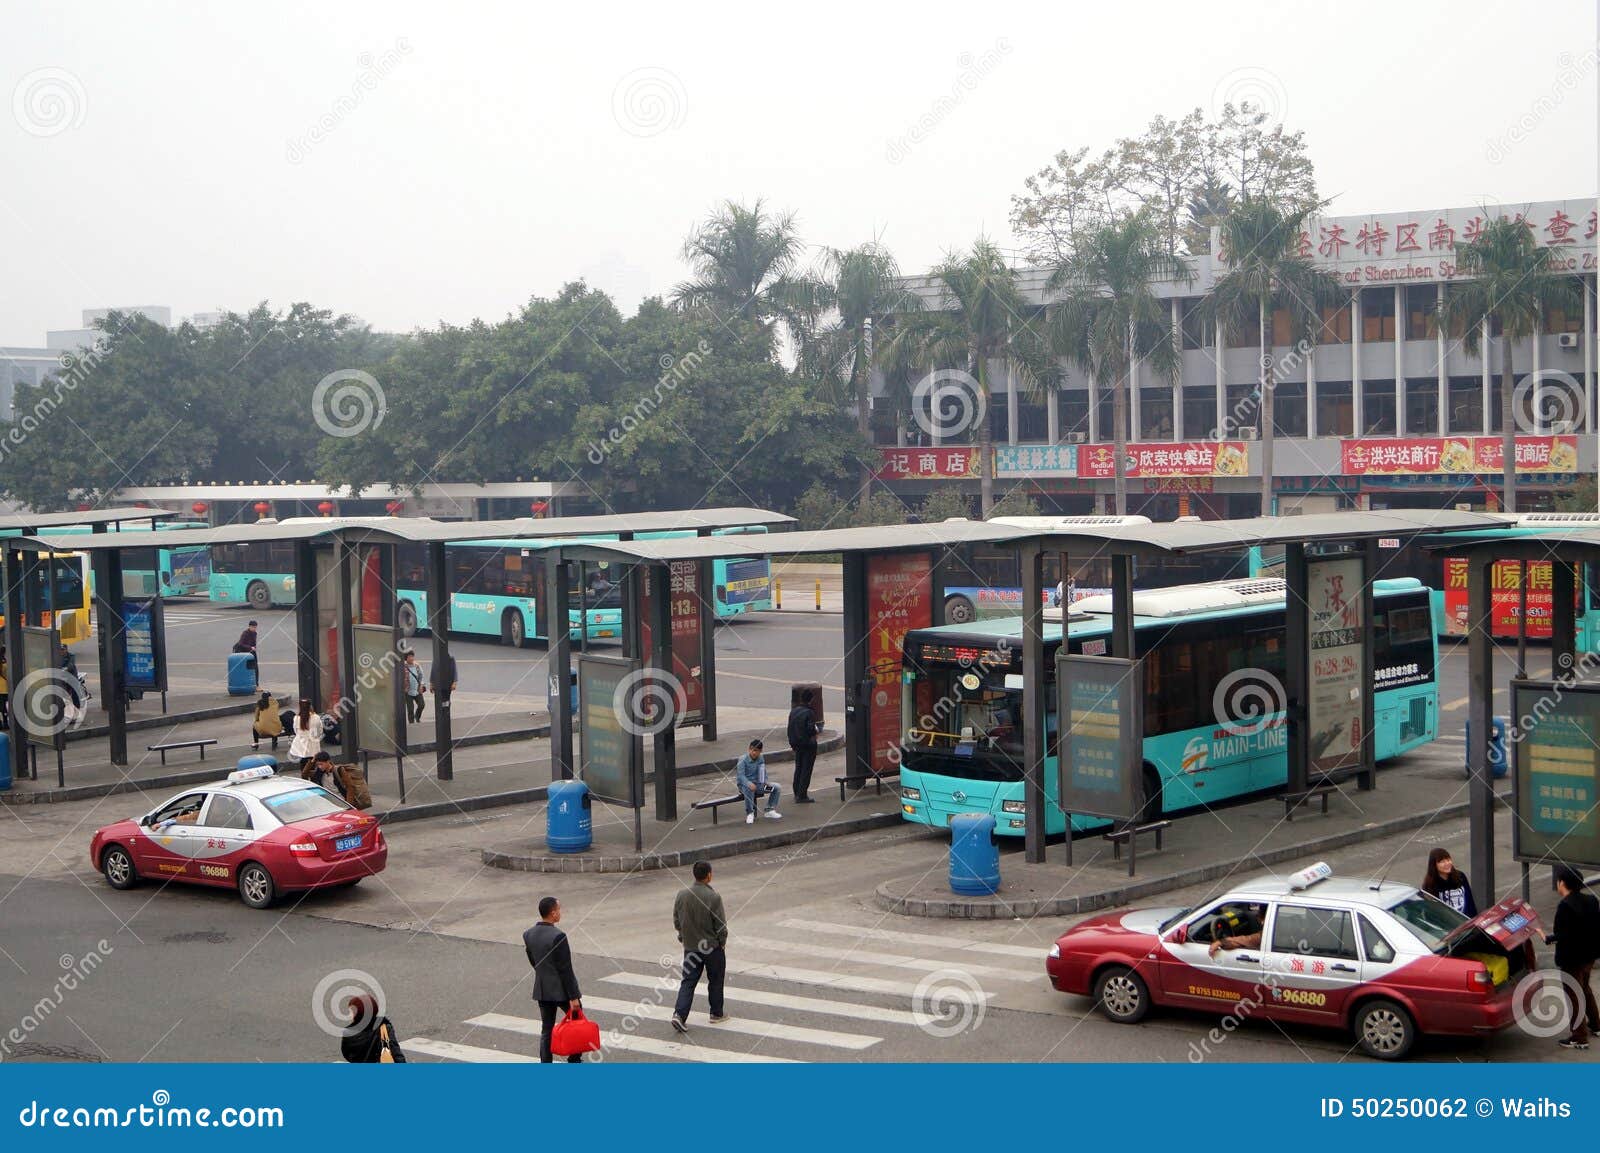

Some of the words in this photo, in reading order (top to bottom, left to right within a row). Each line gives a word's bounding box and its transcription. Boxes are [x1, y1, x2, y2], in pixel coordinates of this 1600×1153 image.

[1344, 267, 1361, 283] of
[1365, 262, 1433, 281] Shenzhen
[1140, 449, 1213, 466] 欣荣快餐店
[1371, 445, 1438, 465] 洪兴达商行
[1213, 728, 1286, 760] MAIN-LINE
[206, 865, 229, 877] 96880
[1282, 988, 1327, 1006] 96880
